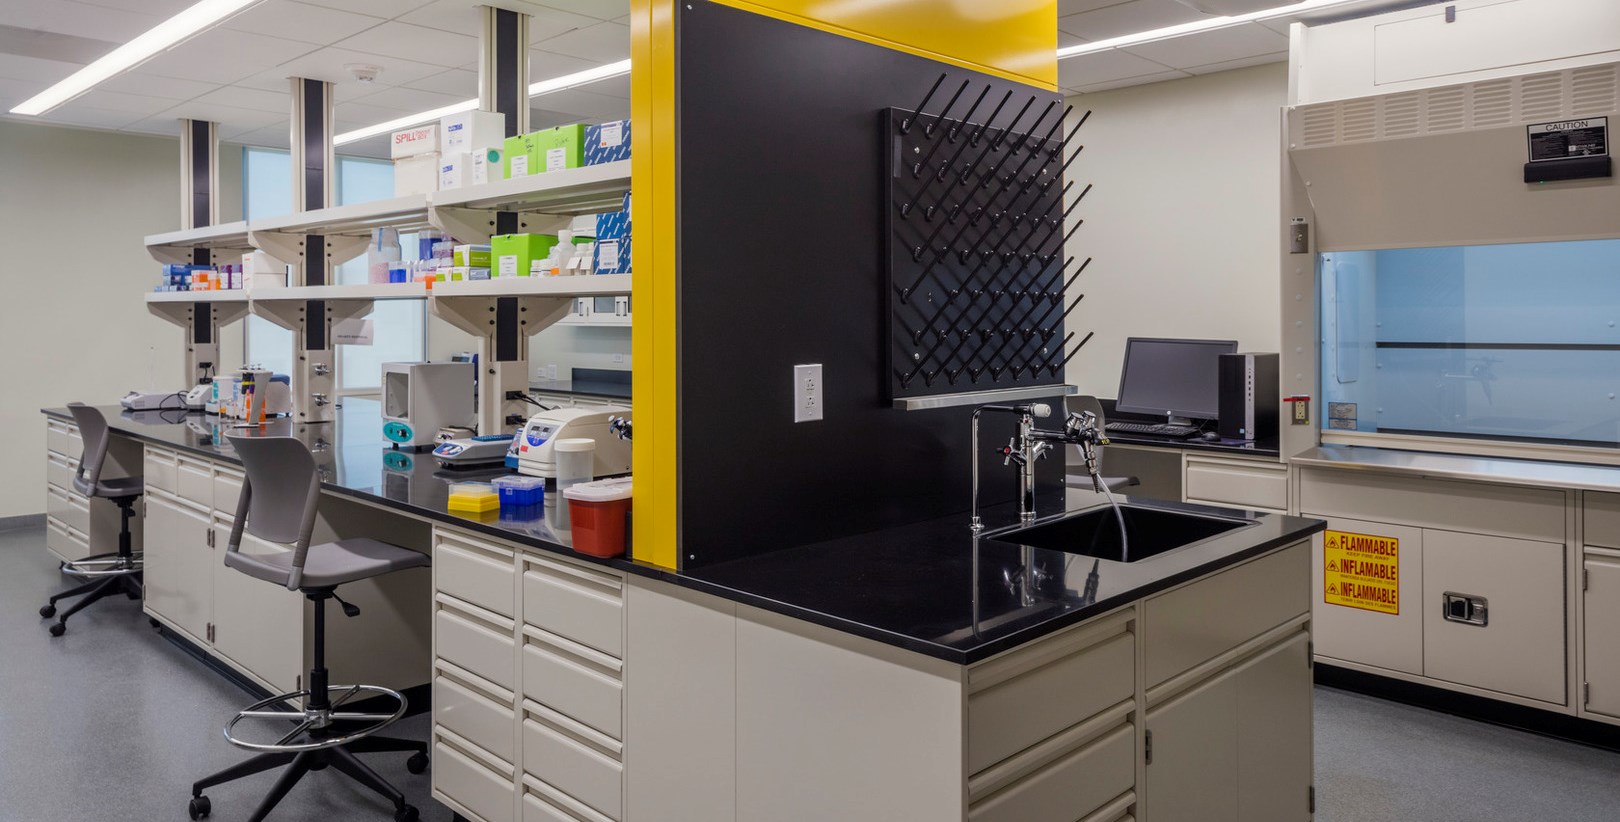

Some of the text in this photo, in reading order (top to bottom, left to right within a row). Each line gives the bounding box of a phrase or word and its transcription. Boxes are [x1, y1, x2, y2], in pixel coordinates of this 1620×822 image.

[1546, 120, 1589, 132] CAUTION
[395, 131, 416, 144] SPILL
[1340, 535, 1396, 556] FLAMMABLE
[1340, 558, 1396, 580] INFLAMABLE
[1340, 581, 1396, 604] INFLAMMABLE
